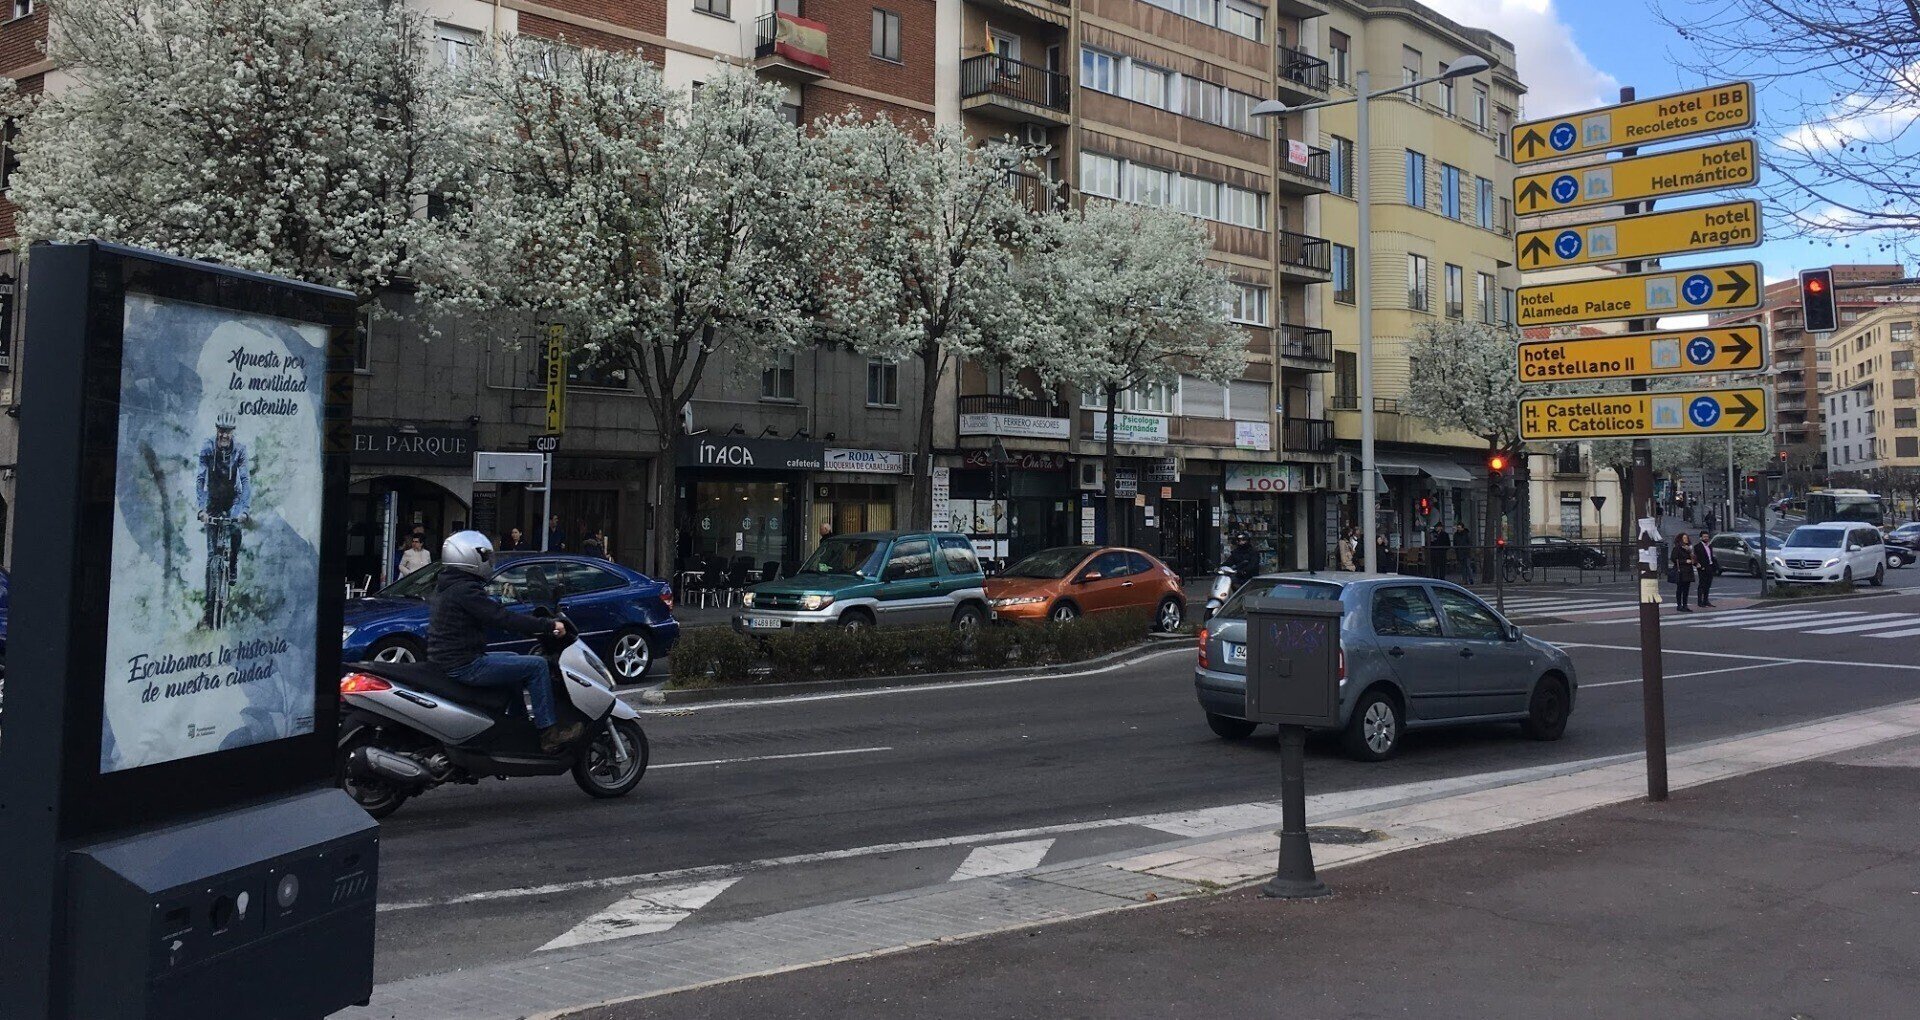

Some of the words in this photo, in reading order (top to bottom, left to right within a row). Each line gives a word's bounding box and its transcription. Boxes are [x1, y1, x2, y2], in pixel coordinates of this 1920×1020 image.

[1658, 97, 1702, 117] hotel
[1712, 89, 1743, 107] IBB
[1626, 117, 1698, 138] Recoletos
[1705, 107, 1743, 123] Coco
[1702, 147, 1747, 167] hotel
[1651, 167, 1748, 191] Helmántico
[1705, 207, 1750, 226] hotel
[1689, 225, 1751, 247] Aragón
[1521, 291, 1554, 306] hotel
[1521, 304, 1579, 320] Alameda
[1584, 299, 1631, 313] Palace
[227, 346, 281, 372] Apuesta
[282, 355, 306, 374] por
[1524, 346, 1566, 361] hotel
[1524, 360, 1621, 377] Castellano
[1625, 357, 1635, 371] II
[228, 372, 245, 391] la
[248, 374, 309, 393] movilidad
[237, 396, 299, 416] sostenible
[1525, 405, 1540, 418] H.
[1546, 401, 1632, 416] Castellano
[1639, 400, 1644, 413] I
[1003, 417, 1031, 428] FERRERO
[1032, 420, 1060, 429] ASESORES
[1526, 420, 1541, 433] H.
[1547, 418, 1561, 432] R.
[1568, 415, 1645, 432] Católicos
[354, 434, 380, 451] EL
[386, 434, 467, 456] PARQUE
[536, 437, 557, 451] GUD
[700, 440, 754, 466] ÍTACA
[786, 459, 820, 469] cafetería
[848, 452, 875, 462] RODA
[865, 463, 902, 471] CABALLEROS
[1246, 478, 1286, 491] 100
[127, 650, 214, 683] Escribamos
[217, 645, 234, 665] la
[235, 636, 290, 661] historia
[141, 682, 160, 704] de
[164, 670, 222, 699] nuestra
[225, 660, 274, 686] ciudad
